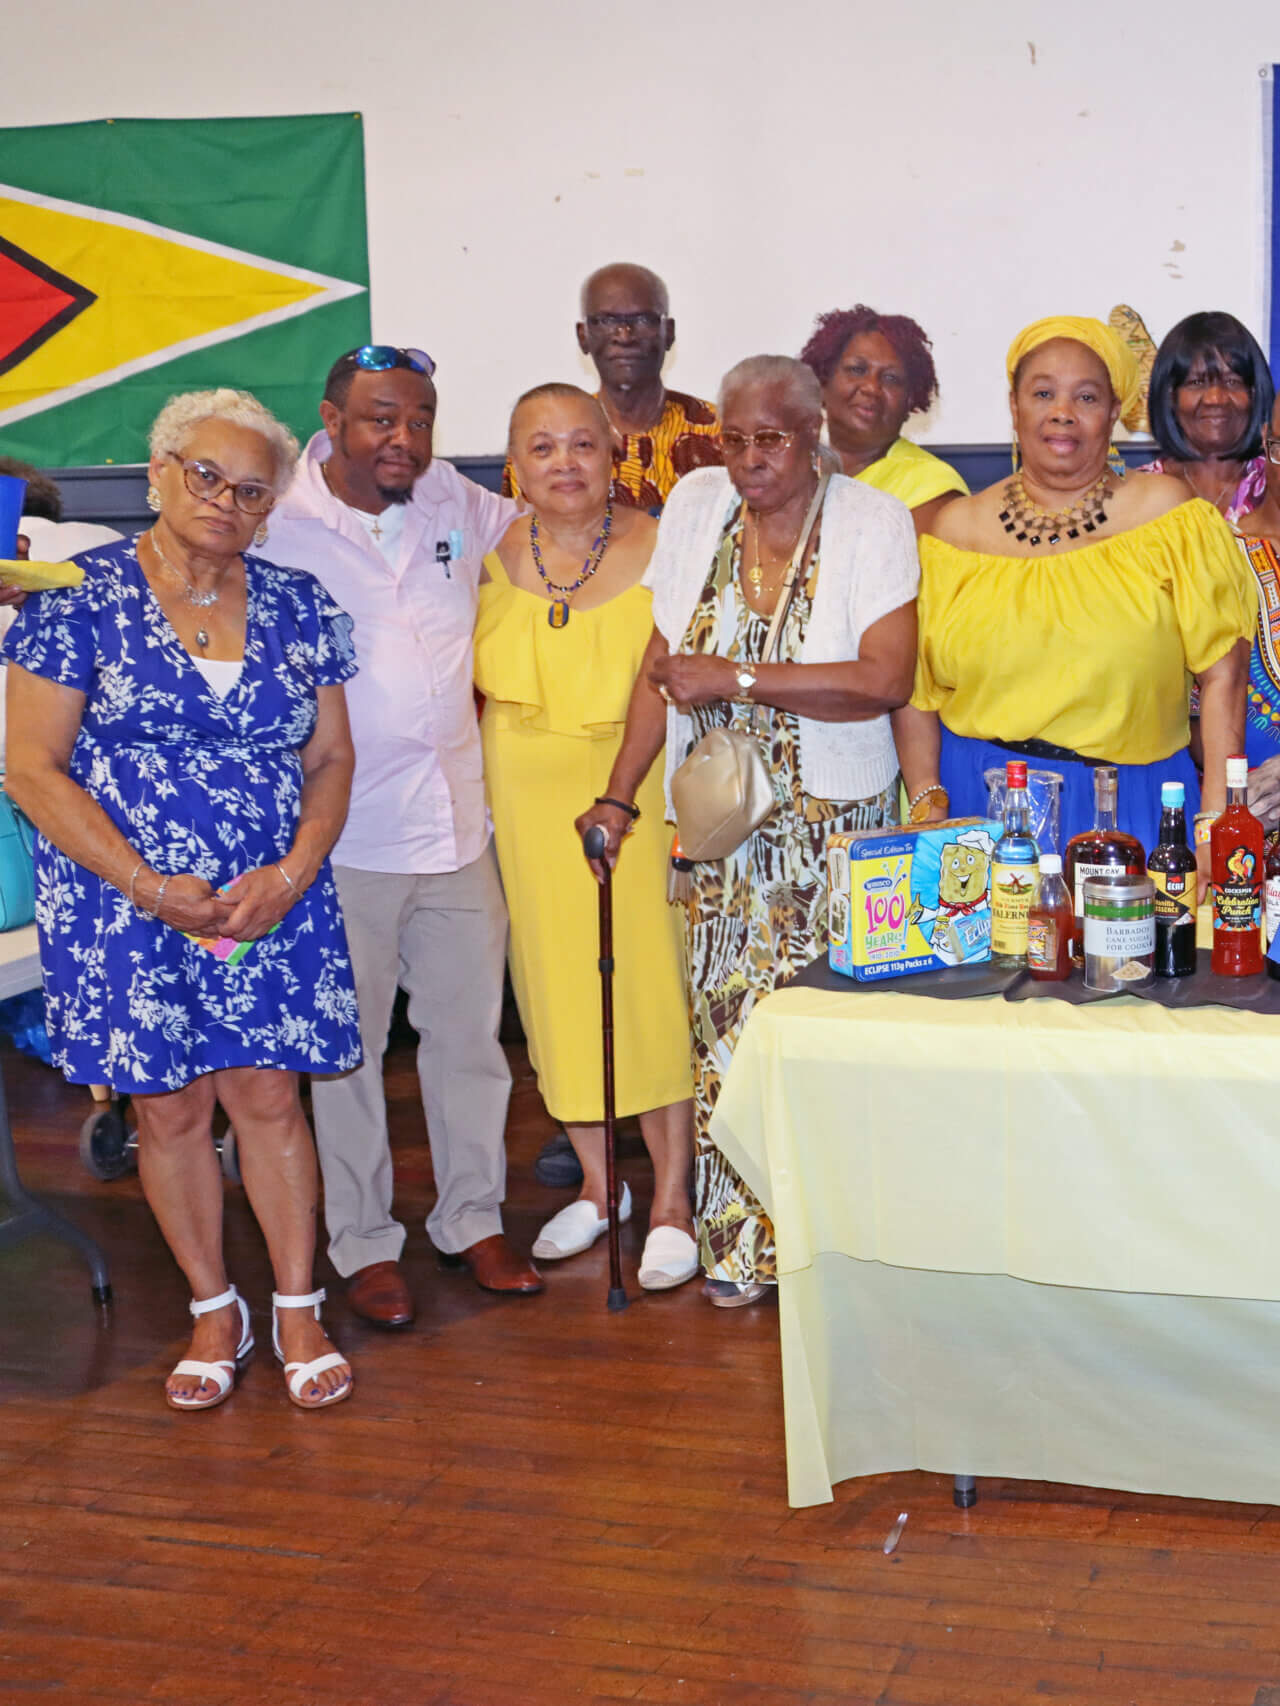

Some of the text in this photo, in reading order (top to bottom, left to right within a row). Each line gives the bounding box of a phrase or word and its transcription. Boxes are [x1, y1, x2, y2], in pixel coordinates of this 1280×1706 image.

[1080, 867, 1104, 875] MOUNT
[1216, 895, 1259, 905] Celebration
[865, 894, 905, 934] 100
[1221, 905, 1252, 915] Punch
[865, 932, 903, 949] YEARS
[1106, 943, 1122, 951] FOR
[864, 963, 889, 975] ECLIPSE
[905, 959, 922, 969] Packs
